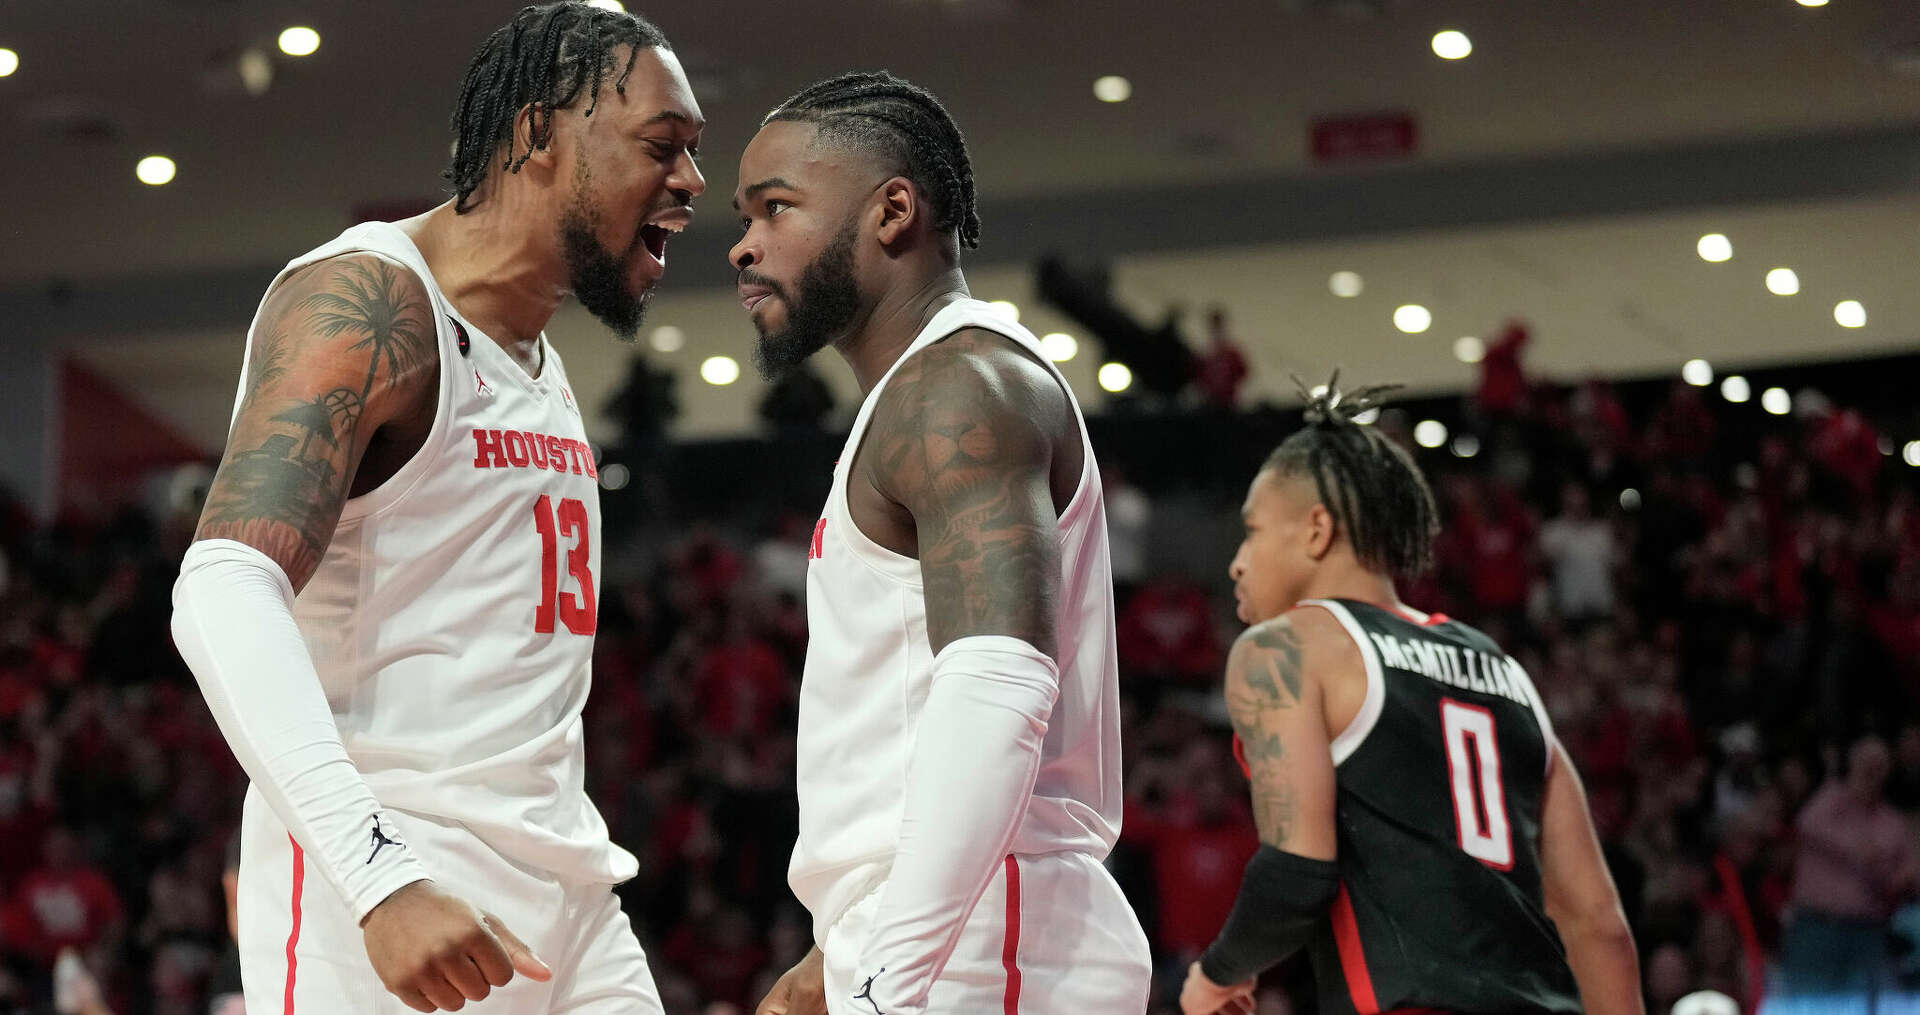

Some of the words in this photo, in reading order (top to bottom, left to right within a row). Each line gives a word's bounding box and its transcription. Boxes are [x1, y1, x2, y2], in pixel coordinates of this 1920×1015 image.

[473, 429, 599, 481] HOUSTO
[533, 494, 597, 635] 13
[1439, 697, 1514, 872] 0
